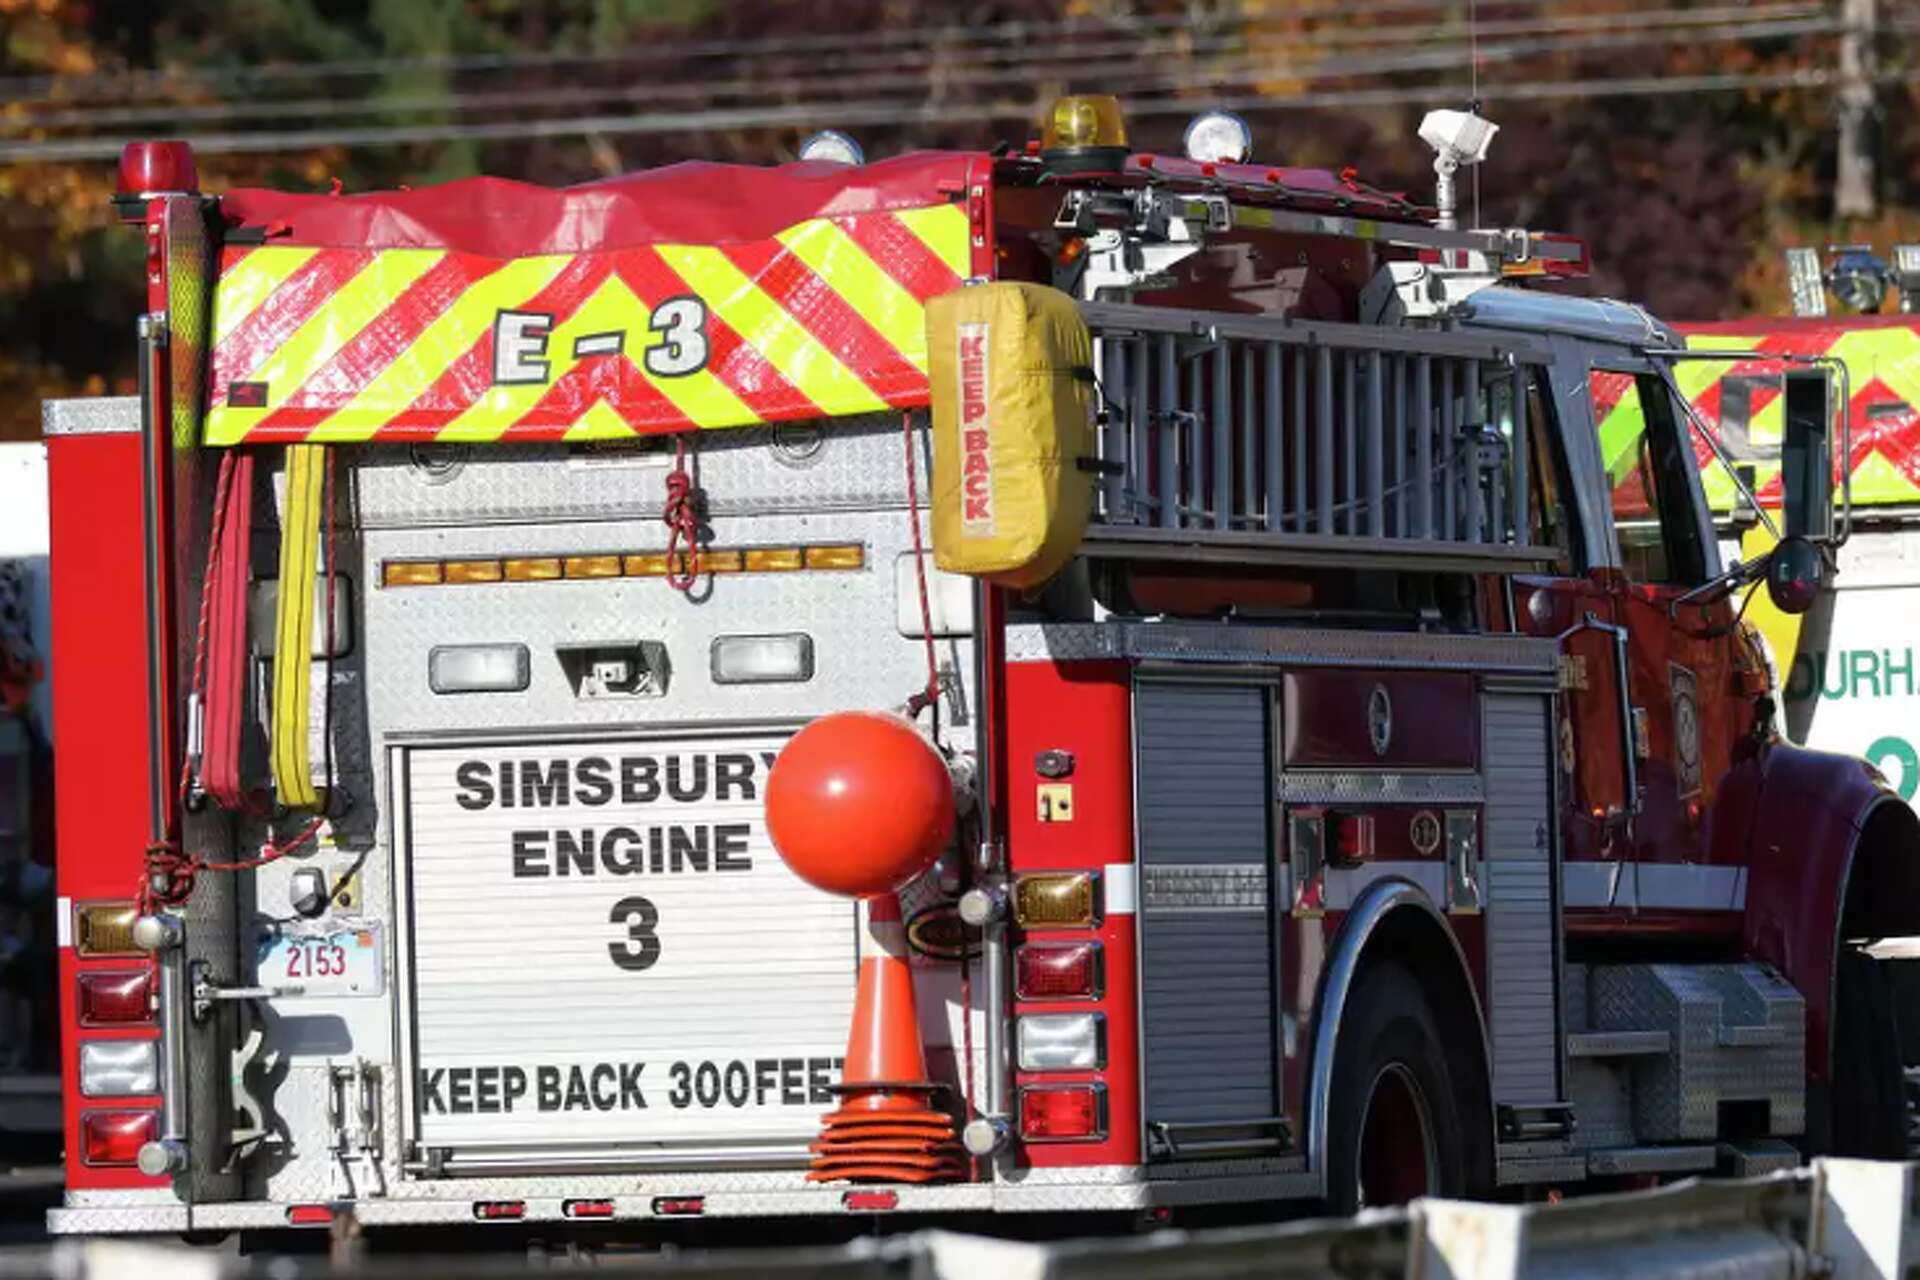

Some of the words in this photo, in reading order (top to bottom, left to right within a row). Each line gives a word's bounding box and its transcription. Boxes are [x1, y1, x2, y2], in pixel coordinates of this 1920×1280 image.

[960, 336, 986, 424] KEEP
[964, 428, 989, 520] BACK
[1784, 647, 1920, 700] DURH
[512, 823, 752, 877] ENGINE
[608, 896, 661, 971] 3
[287, 945, 346, 977] 2153
[420, 1066, 527, 1115] KEEP
[537, 1062, 648, 1112] BACK
